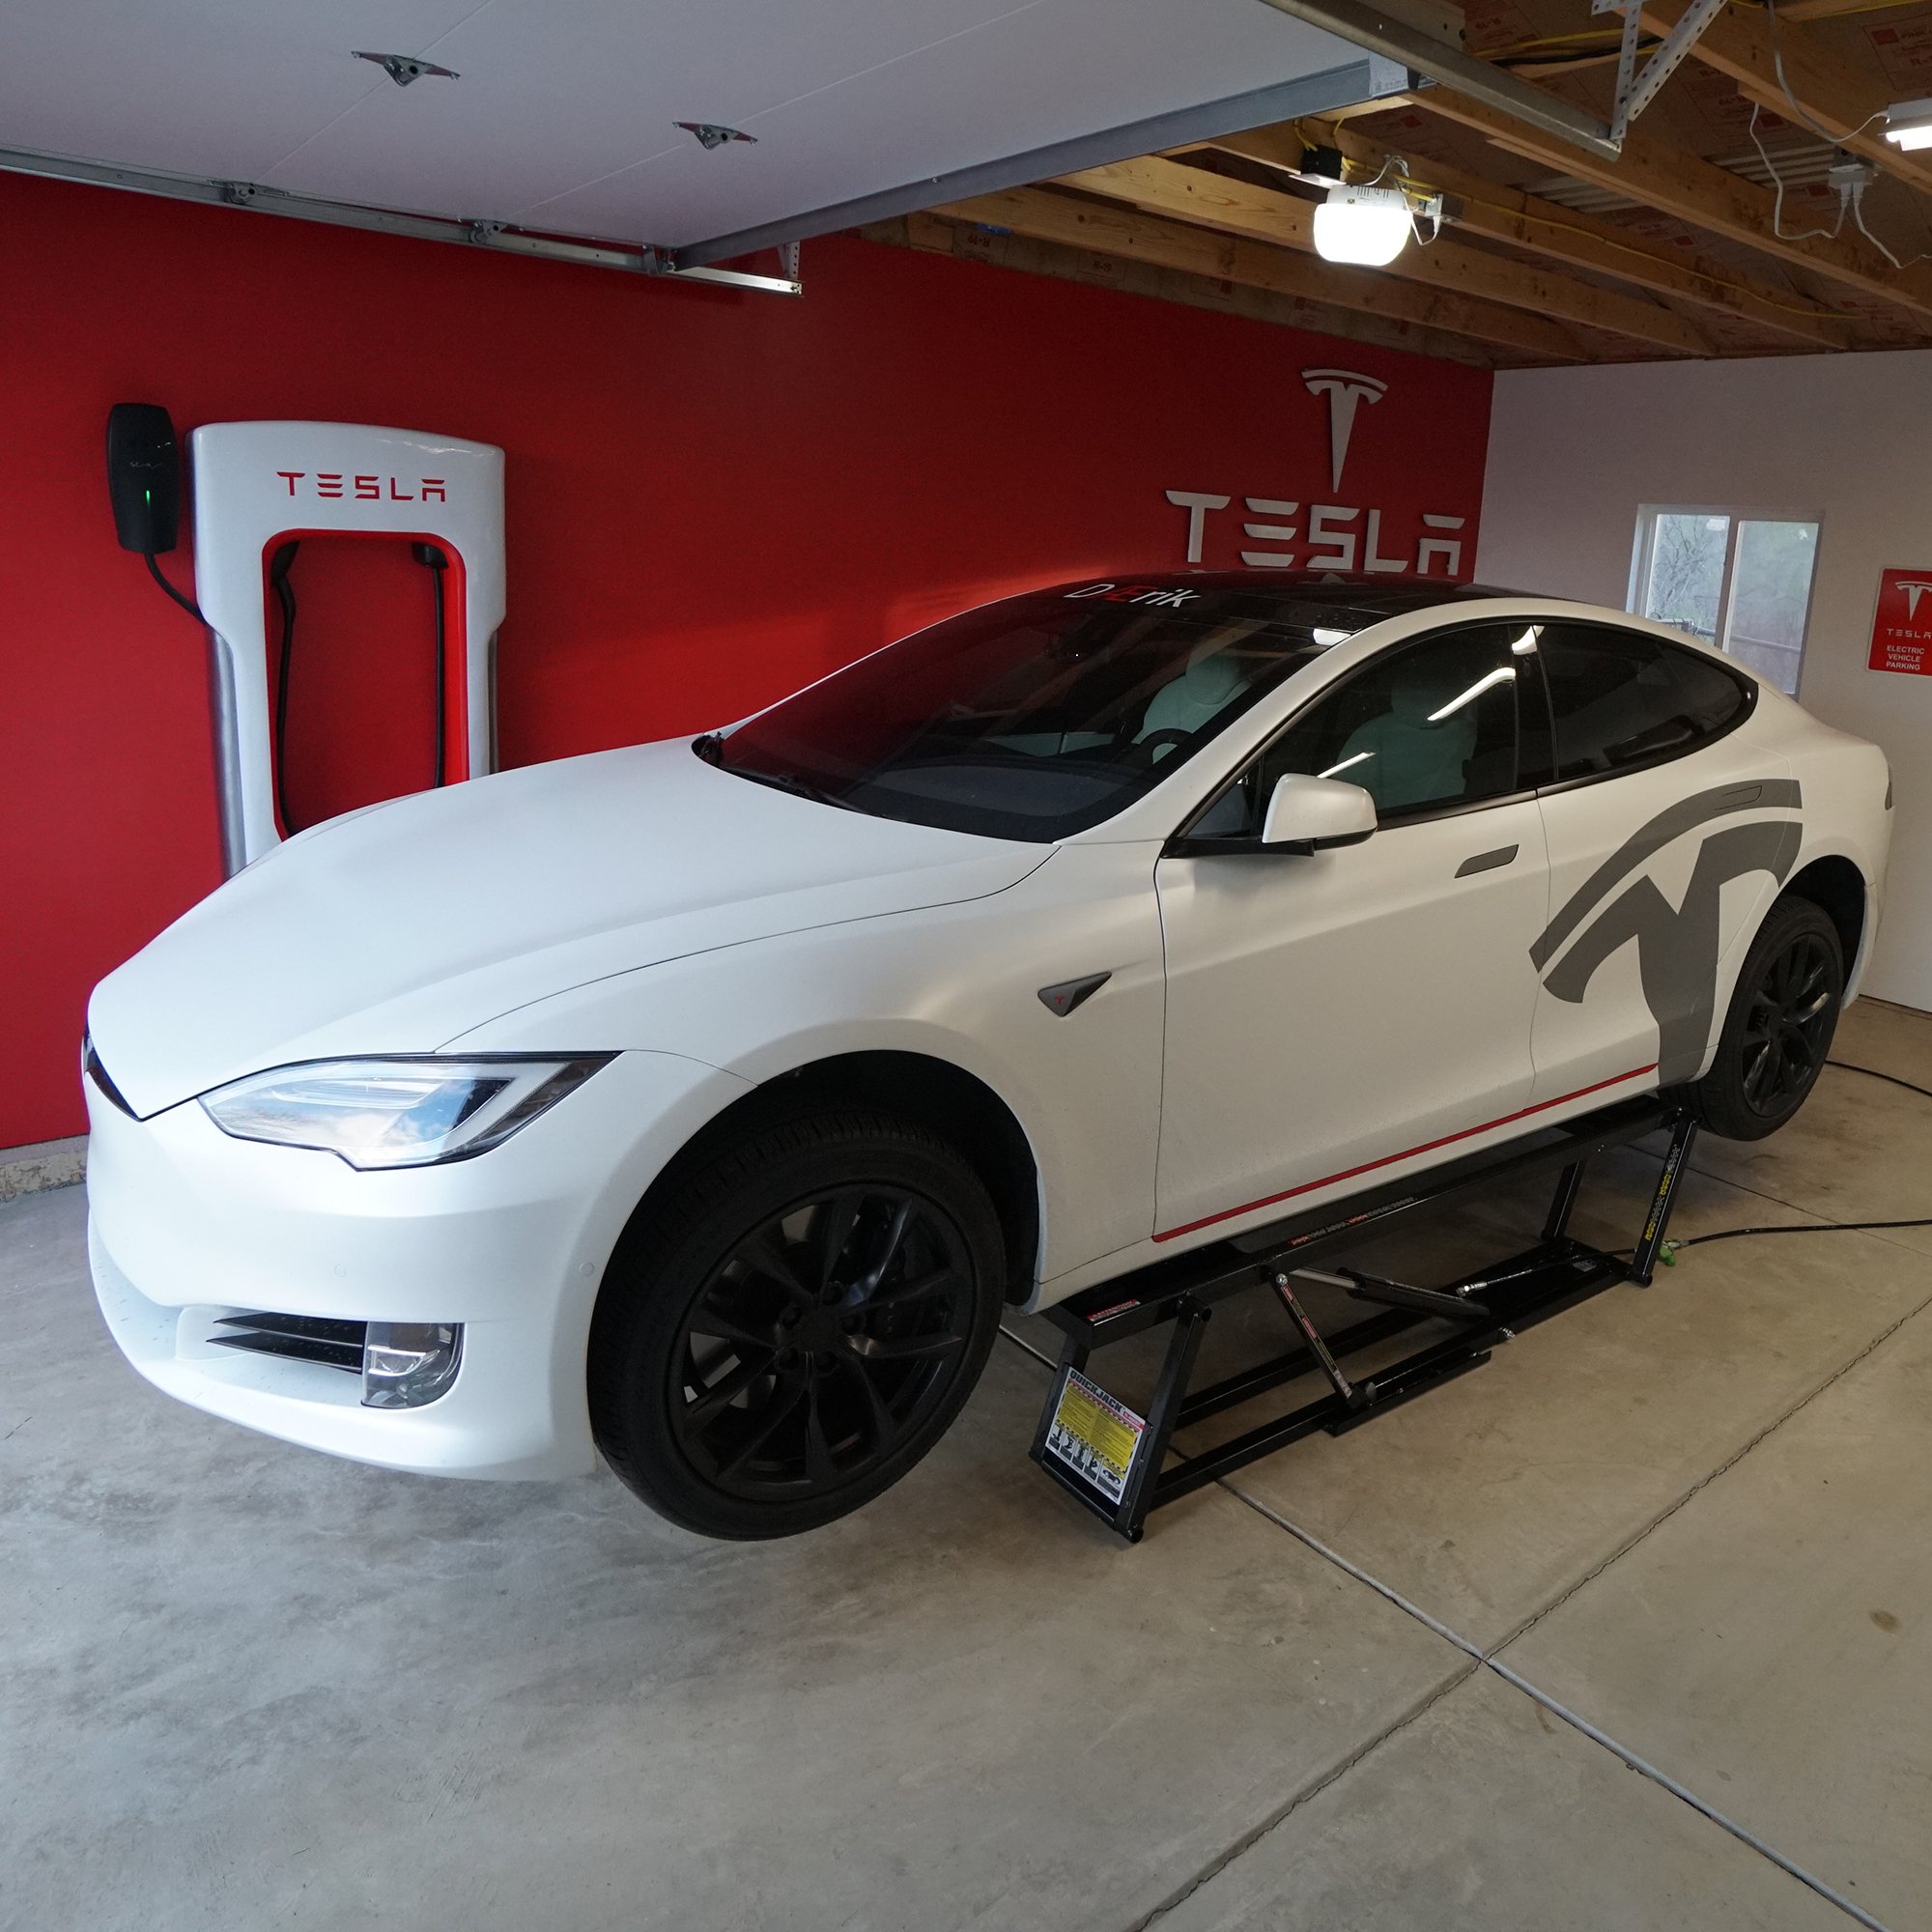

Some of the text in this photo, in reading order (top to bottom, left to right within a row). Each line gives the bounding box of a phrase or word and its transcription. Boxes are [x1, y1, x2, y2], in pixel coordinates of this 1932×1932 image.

[276, 470, 446, 502] TESLA
[1165, 490, 1465, 576] TESLA
[1887, 628, 1931, 639] TESLA
[1887, 645, 1925, 655] ELECTRIC
[1888, 653, 1921, 663] VEHICLE
[1886, 662, 1920, 670] PARKING
